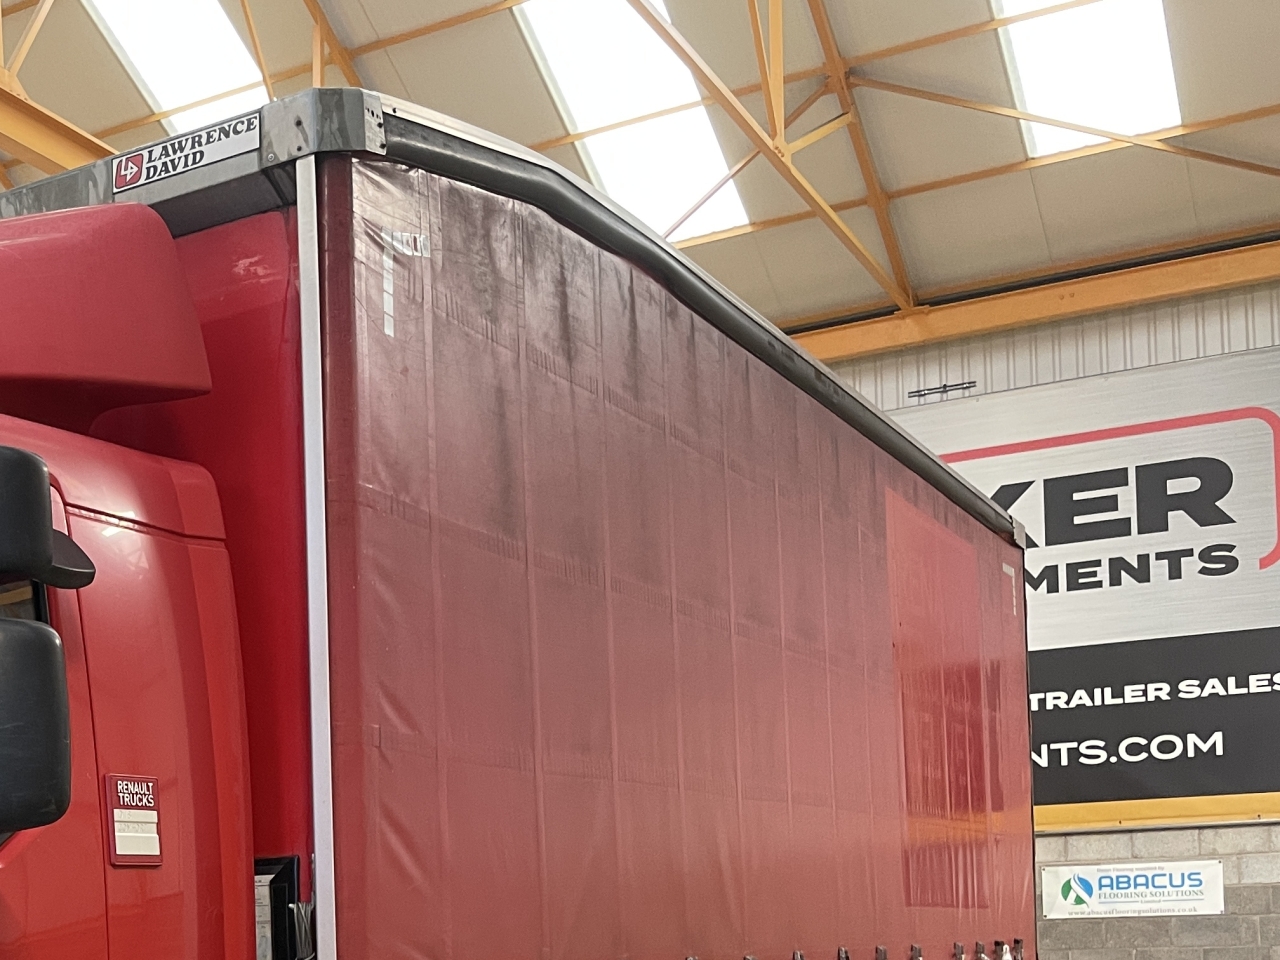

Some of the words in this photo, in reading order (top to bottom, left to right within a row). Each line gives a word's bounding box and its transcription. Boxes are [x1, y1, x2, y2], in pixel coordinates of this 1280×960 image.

[146, 116, 258, 164] LAWRENCE
[144, 150, 205, 181] DAVID
[1029, 680, 1171, 712] TRAILER
[117, 781, 153, 795] RENAULT
[118, 793, 155, 807] TRUCKS
[1098, 872, 1203, 891] ABACUS
[1098, 892, 1148, 900] FLOORING
[1149, 889, 1204, 898] SOLUTIONS
